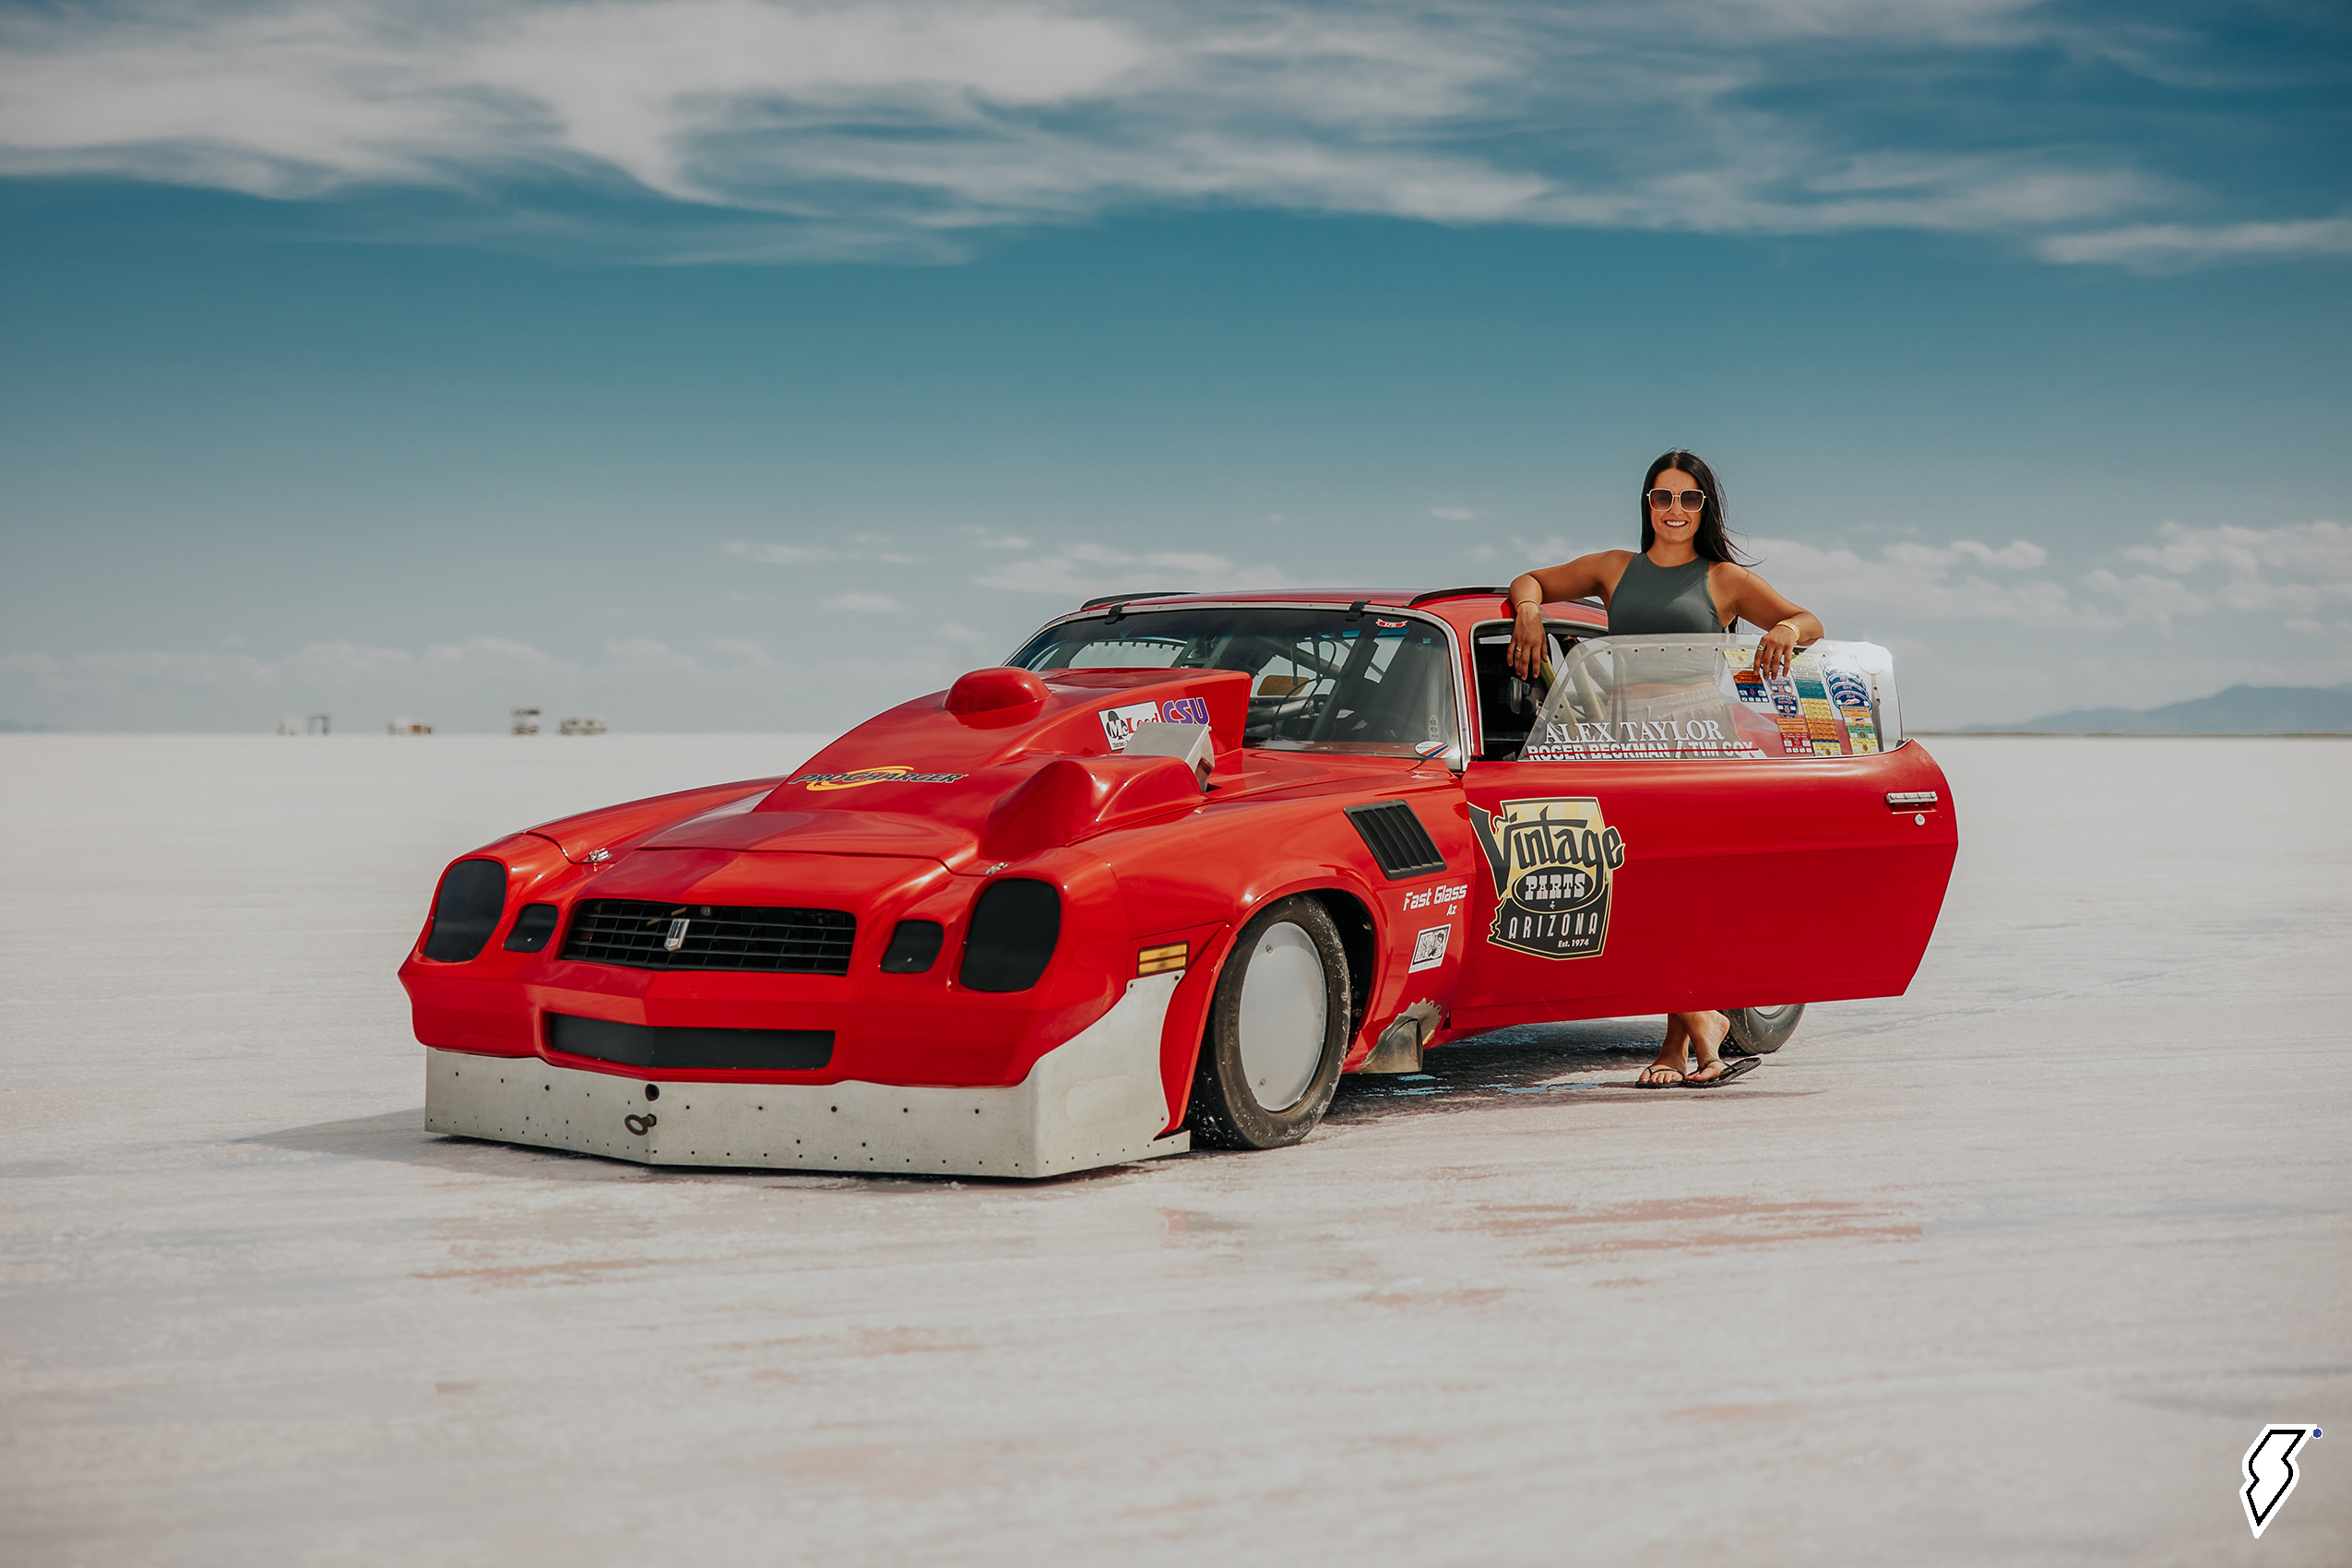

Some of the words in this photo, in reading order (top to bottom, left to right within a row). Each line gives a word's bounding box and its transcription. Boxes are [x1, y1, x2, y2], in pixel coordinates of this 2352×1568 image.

[1162, 696, 1210, 726] CSU
[1544, 721, 1616, 744] ALEX
[1620, 719, 1725, 742] TAYLOR
[1526, 743, 1587, 761] ROGER
[1587, 742, 1669, 760] BECKMAN
[1688, 741, 1720, 757] TIM
[1722, 740, 1753, 758] COX
[788, 772, 964, 784] PROCHARGER
[1467, 802, 1625, 899] Vintage
[1403, 887, 1432, 911] Fast
[1433, 885, 1467, 905] Glass
[1525, 873, 1586, 900] PARTS
[1446, 904, 1458, 916] Az
[1508, 912, 1598, 939] ARIZONA
[1557, 940, 1570, 948] Est.
[1572, 938, 1589, 947] 1974
